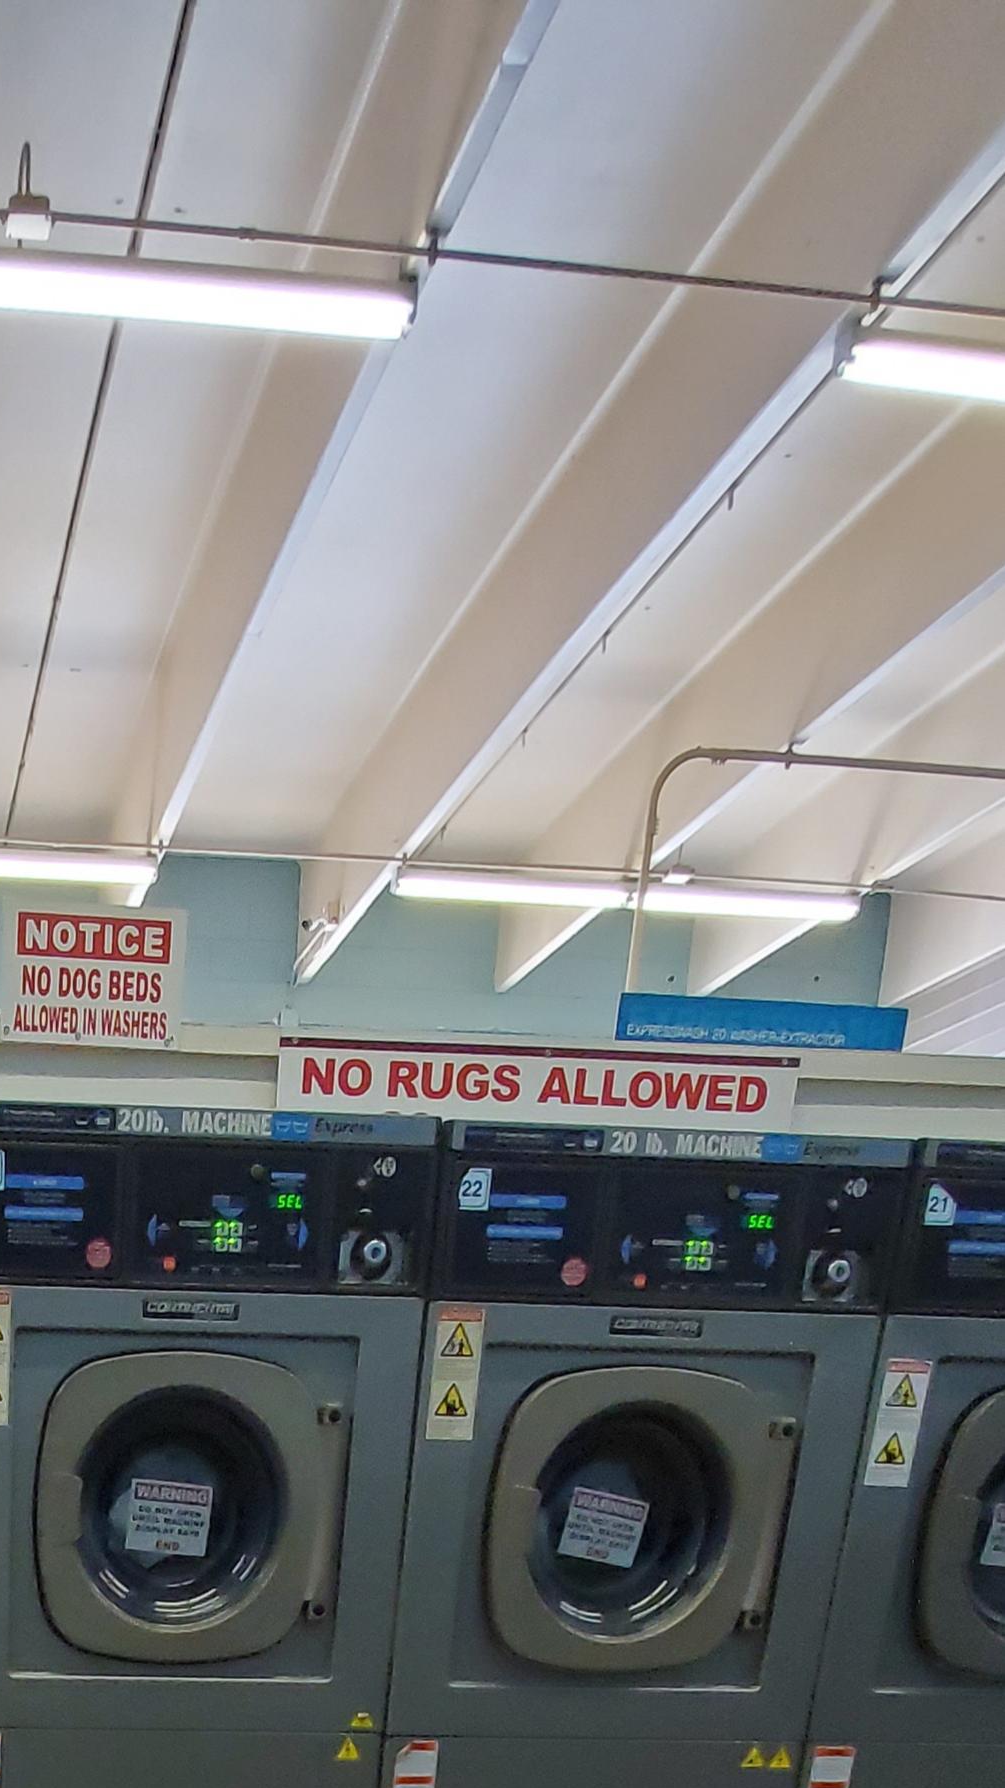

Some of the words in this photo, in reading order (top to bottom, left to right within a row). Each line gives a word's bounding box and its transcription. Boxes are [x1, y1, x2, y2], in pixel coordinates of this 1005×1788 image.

[25, 919, 164, 957] NOTICE
[22, 965, 51, 996] NO
[58, 967, 101, 999] DOG
[109, 970, 162, 1003] BEDS
[13, 1004, 79, 1034] ALLOWED
[83, 1008, 97, 1036] IN
[101, 1009, 167, 1040] WASHERS
[301, 1057, 372, 1096] NO
[387, 1061, 521, 1101] RUGS
[537, 1067, 768, 1113] ALLOWED
[180, 1110, 272, 1136] MACHINE
[314, 1117, 374, 1137] Express
[609, 1131, 637, 1153] 20
[675, 1132, 764, 1160] MACHINE
[276, 1194, 303, 1210] SEL
[461, 1180, 483, 1198] 22
[929, 1196, 948, 1214] 21
[749, 1214, 774, 1230] SEL
[137, 1484, 207, 1505] WARNING
